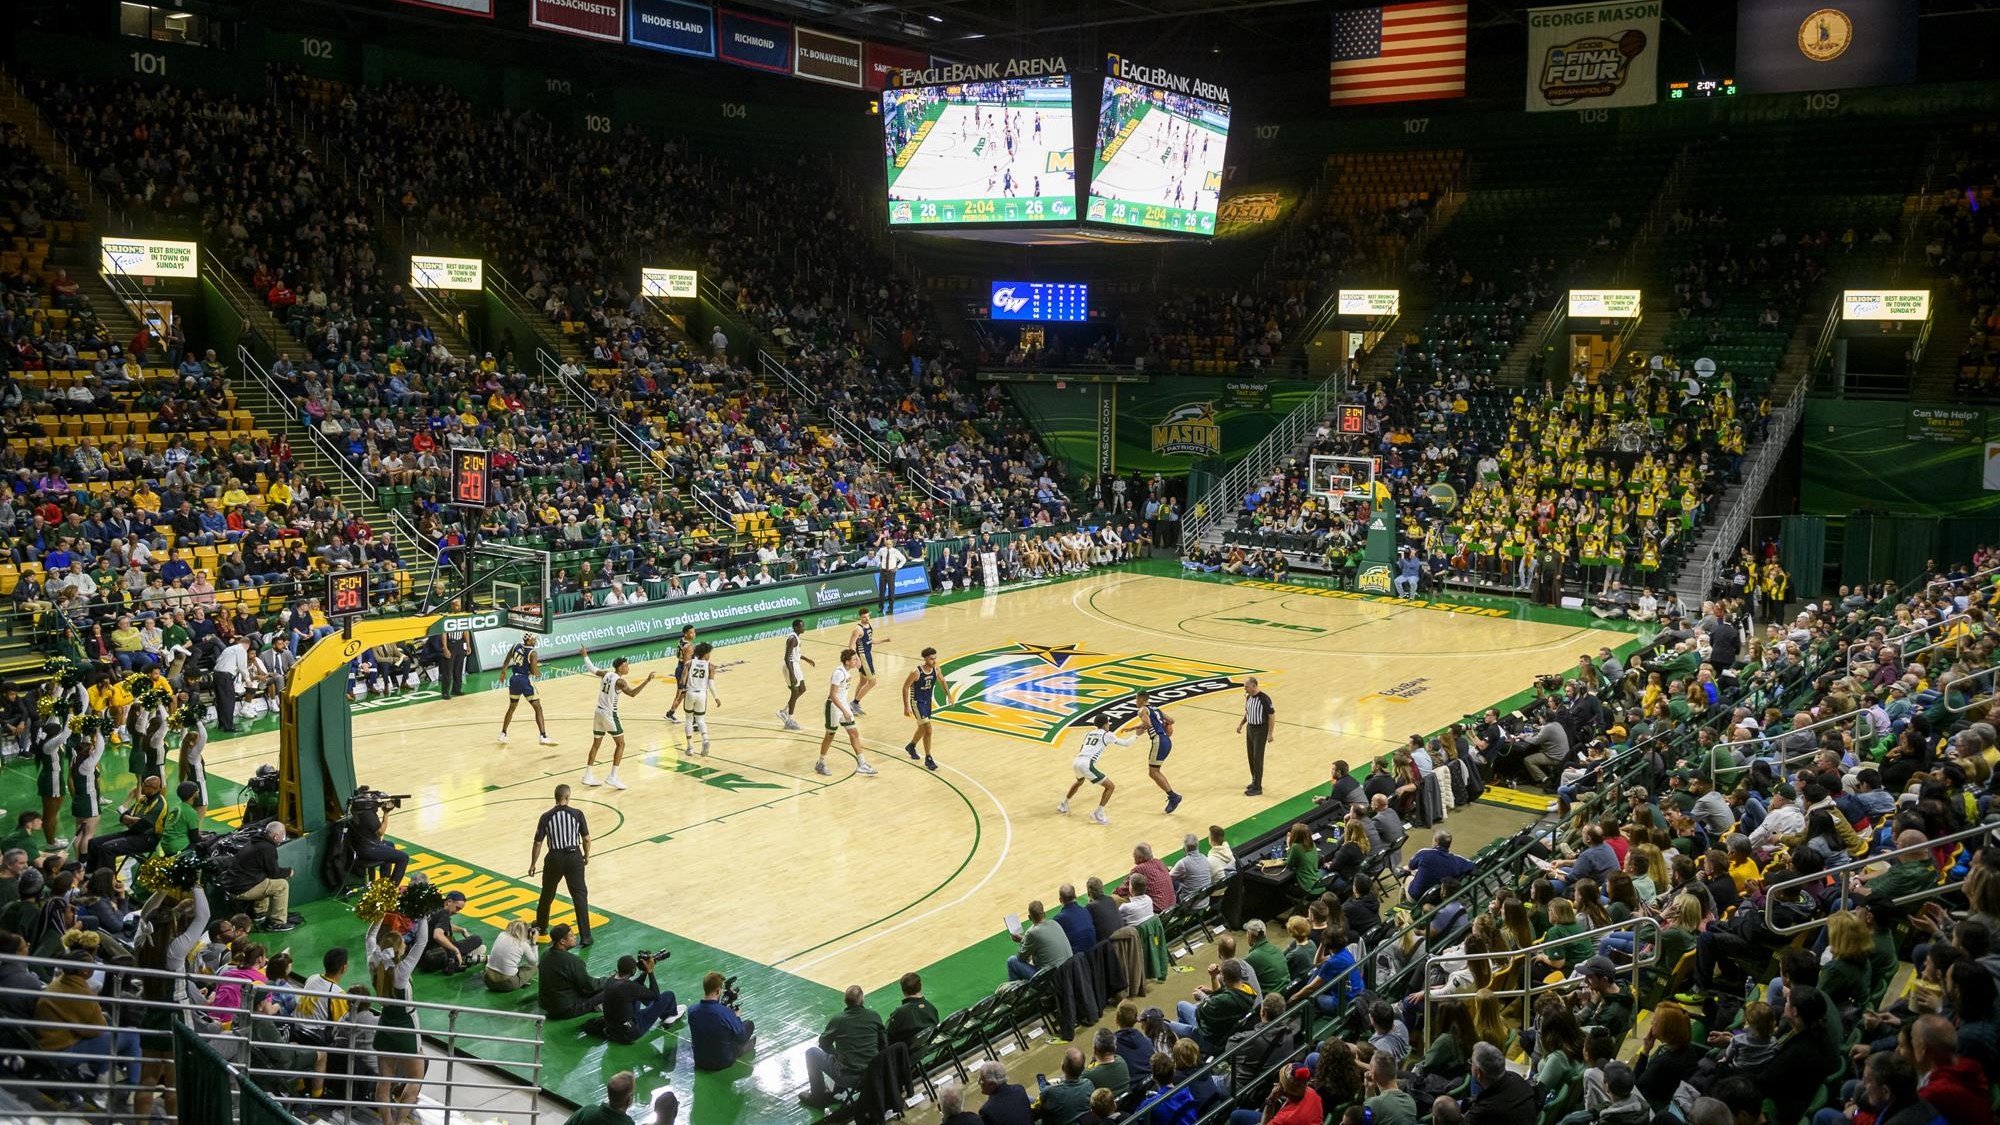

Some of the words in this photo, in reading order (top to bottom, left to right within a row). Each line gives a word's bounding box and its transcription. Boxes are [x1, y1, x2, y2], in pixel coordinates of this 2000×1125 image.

[540, 0, 617, 17] ASSACHUSETTS
[1531, 11, 1594, 28] GEORGE
[1598, 4, 1659, 22] MASON
[642, 13, 672, 28] RHODE
[673, 18, 704, 34] ISLAND
[301, 37, 334, 59] 102
[735, 33, 775, 49] RICHMOND
[130, 51, 167, 76] 101
[799, 47, 809, 56] ST.
[810, 50, 859, 68] BONAVENTURE
[1566, 50, 1620, 64] FINAL
[873, 63, 891, 73] SAI
[1004, 56, 1067, 78] ARENA
[1546, 62, 1618, 84] FOUR
[1192, 78, 1230, 103] ARENA
[1671, 89, 1683, 98] 28
[1697, 81, 1716, 90] 2:04
[1803, 93, 1840, 111] 109
[721, 103, 746, 119] 104
[1577, 108, 1608, 124] 108
[585, 114, 611, 133] 103
[1255, 125, 1280, 139] 107
[1402, 118, 1429, 134] 107
[920, 203, 937, 217] 28
[964, 200, 995, 214] 2:04
[1025, 201, 1043, 214] 26
[1112, 204, 1126, 218] 28
[1145, 206, 1167, 221] 2:04
[1184, 212, 1197, 226] 26
[150, 246, 163, 254] BEST
[166, 247, 191, 255] BRUNCH
[1345, 408, 1363, 417] 2:04
[1912, 409, 1932, 417] Can
[1933, 410, 1949, 418] We
[1951, 411, 1979, 420] Help?
[1343, 417, 1360, 431] 20
[1102, 399, 1110, 474] OMASON.COM
[1154, 424, 1218, 450] MASON
[1166, 444, 1204, 452] PATRIOTS
[464, 456, 485, 471] 2:04
[461, 471, 482, 500] 20
[338, 577, 362, 590] 2:04
[1232, 580, 1372, 600] GEORGE
[1360, 575, 1390, 590] MASON
[336, 590, 357, 608] 20
[816, 591, 841, 602] MASON
[1371, 596, 1511, 617] MASON
[444, 614, 499, 632] GEICO
[491, 635, 553, 656] Affoble,
[555, 624, 615, 649] convenient
[617, 618, 650, 639] quality
[652, 616, 662, 627] in
[664, 609, 711, 630] graduate
[711, 601, 752, 619] business
[754, 595, 803, 614] education.
[692, 668, 705, 680] 23
[602, 682, 610, 694] 11
[350, 690, 443, 712] EICO
[931, 653, 1254, 741] MASON
[1086, 681, 1229, 726] ATIOTS
[1086, 737, 1099, 746] 10
